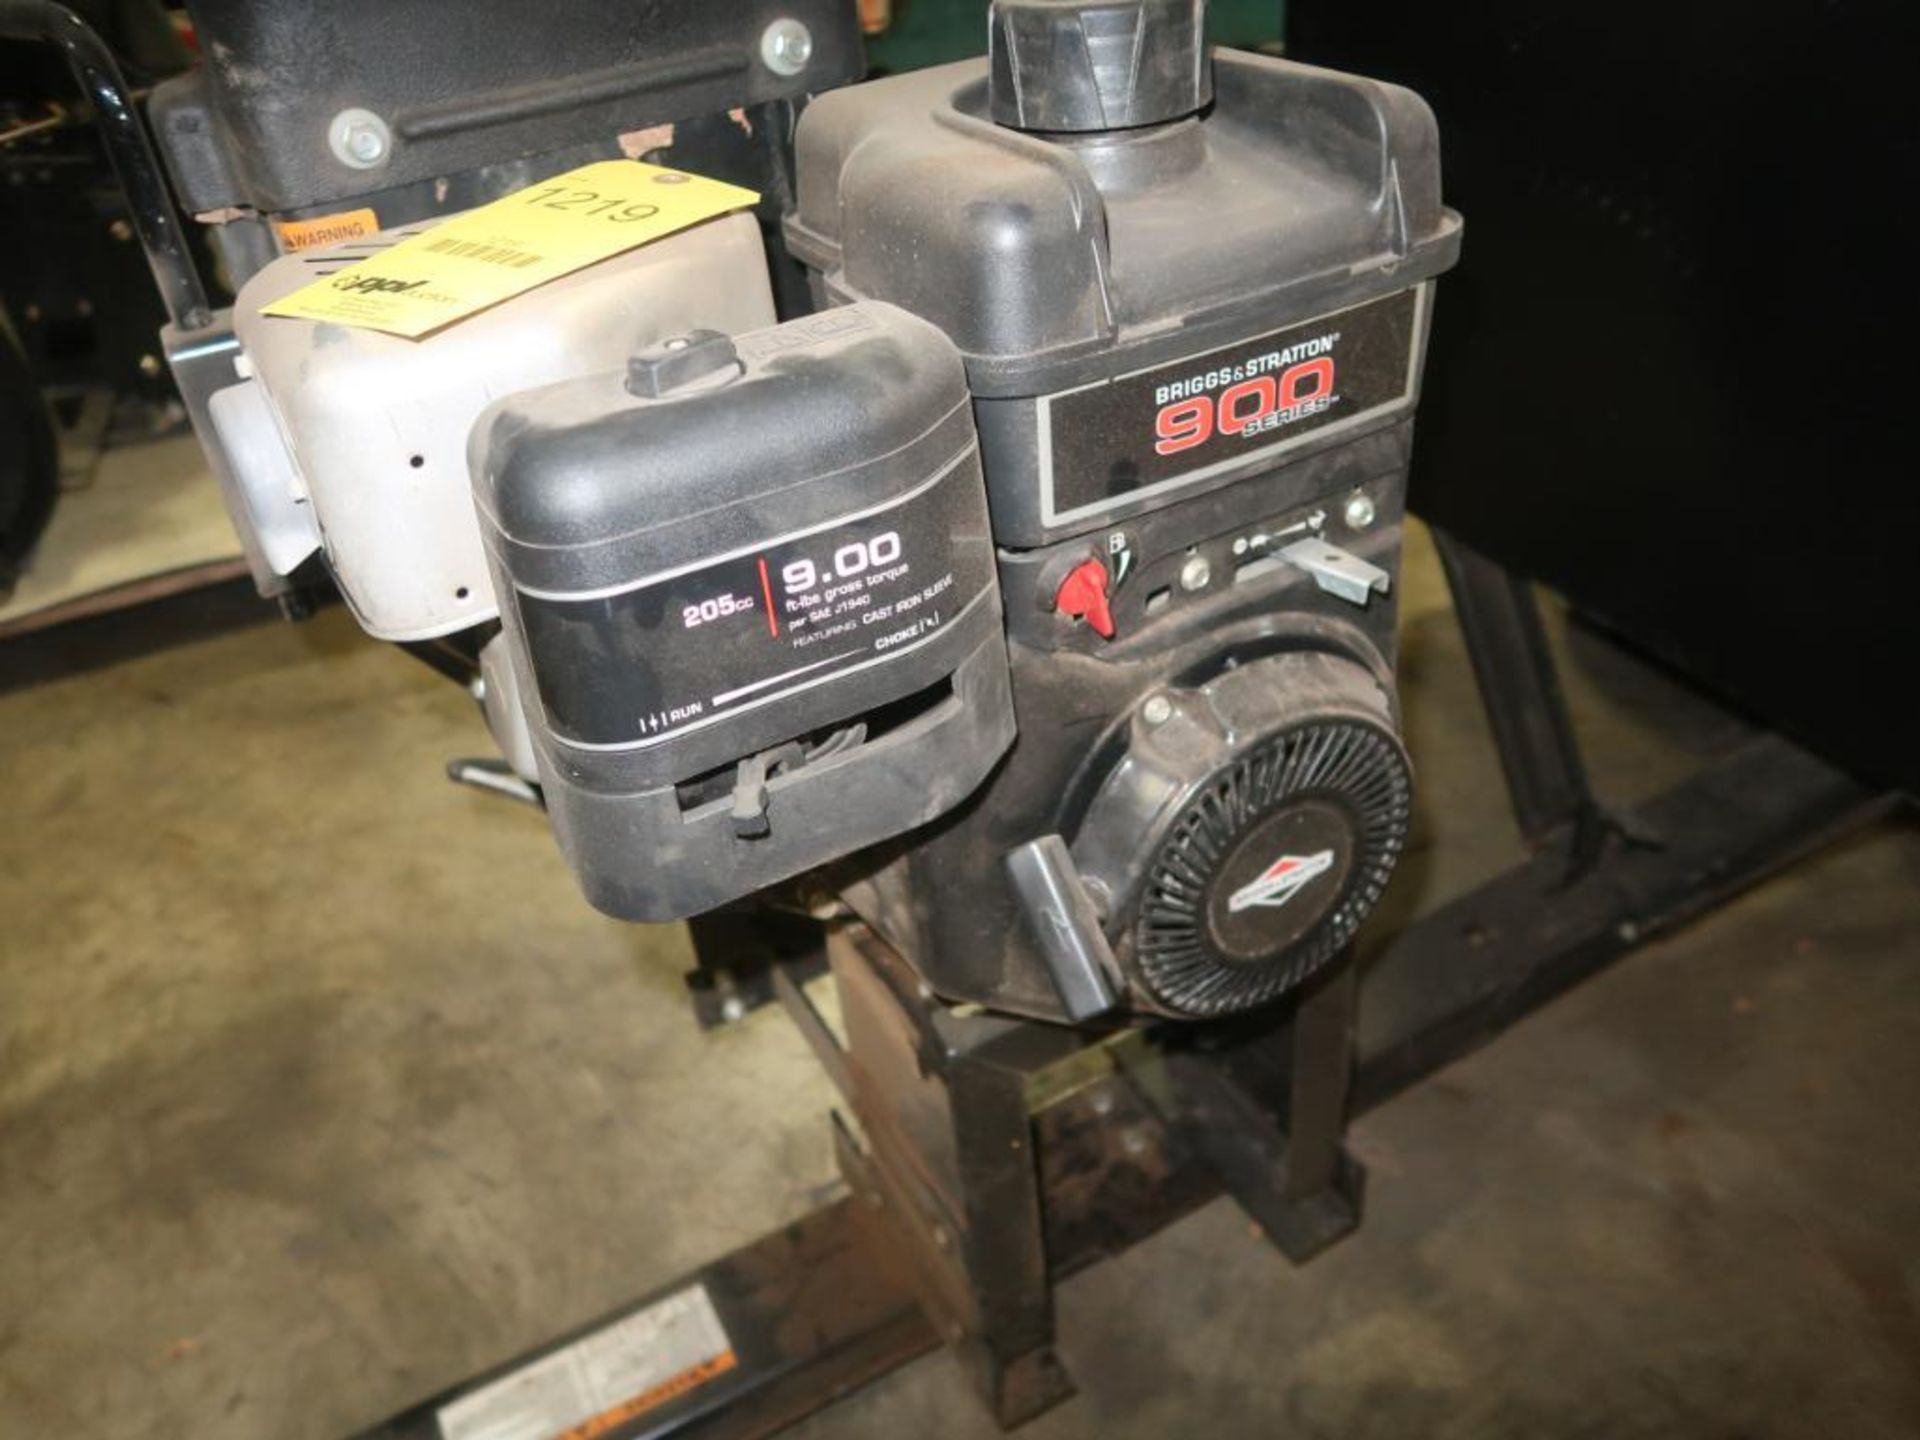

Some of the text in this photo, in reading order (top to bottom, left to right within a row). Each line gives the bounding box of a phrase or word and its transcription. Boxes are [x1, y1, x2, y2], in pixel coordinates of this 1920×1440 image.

[526, 184, 661, 223] 1219
[294, 222, 364, 248] WARNING
[1155, 356, 1335, 456] 900
[1241, 396, 1330, 438] SERIES
[782, 531, 901, 594] 9.00
[824, 580, 864, 602] gross
[866, 563, 910, 588] torque
[788, 594, 871, 632] per SAE J1940
[792, 620, 858, 649] FEATURING
[862, 605, 893, 625] CAST
[895, 595, 923, 614] IRON
[874, 625, 919, 650] CHOKE
[669, 702, 703, 723] RUN
